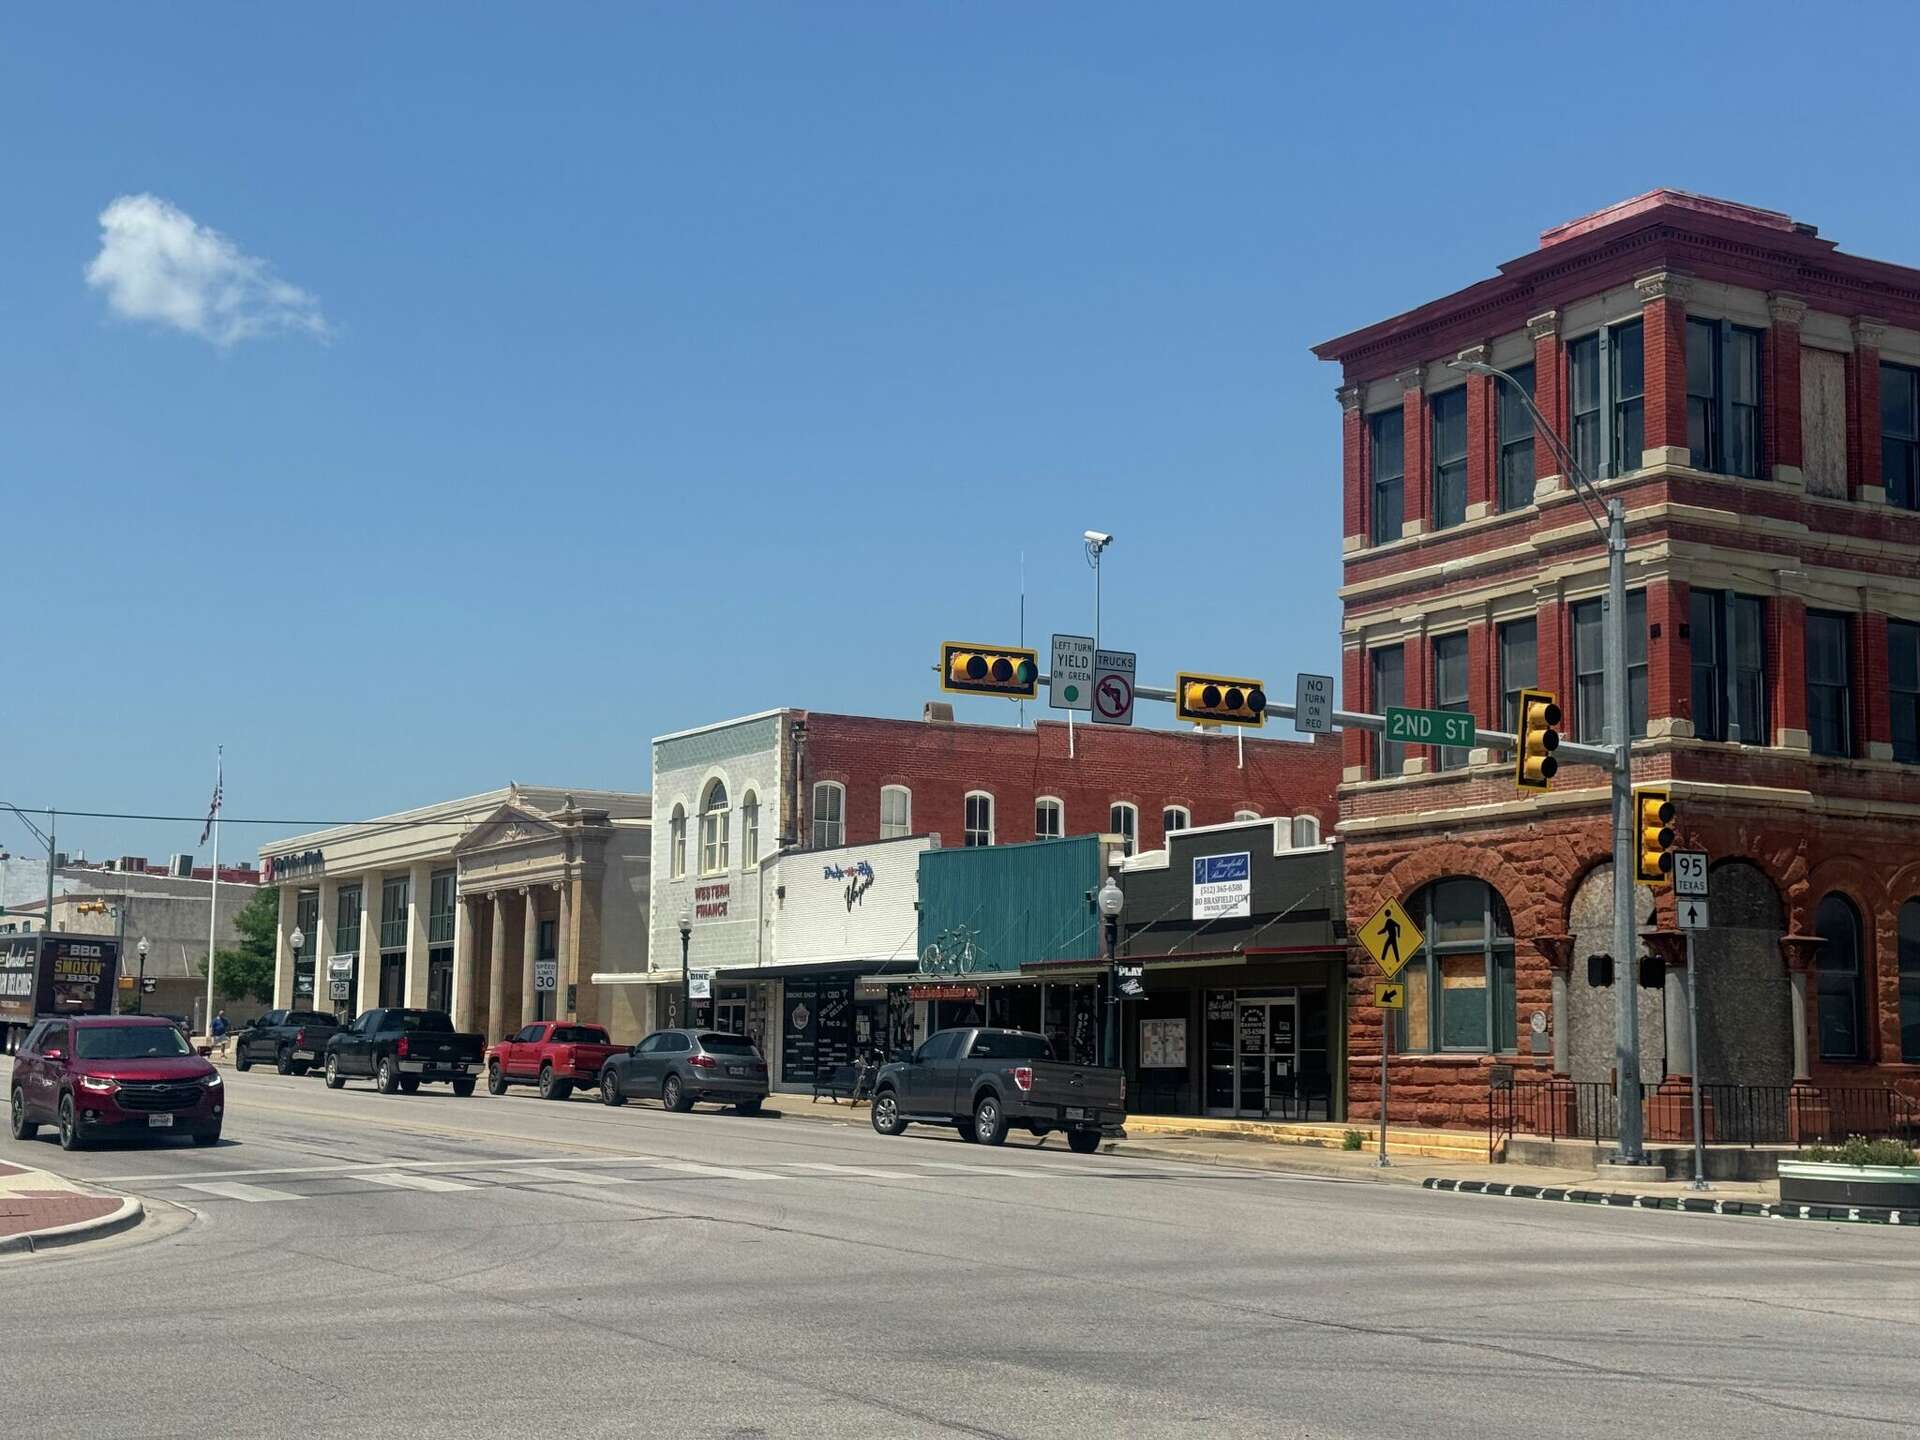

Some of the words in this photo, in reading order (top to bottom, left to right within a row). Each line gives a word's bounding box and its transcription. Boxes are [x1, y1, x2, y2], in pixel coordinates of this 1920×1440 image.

[1055, 641, 1071, 650] LEFT
[1074, 642, 1092, 653] TURN
[1058, 654, 1089, 669] YIELD
[1098, 655, 1134, 668] TRUCKS
[1053, 670, 1064, 679] ON
[1068, 671, 1091, 681] GREEN
[1307, 680, 1323, 691] NO
[1304, 693, 1326, 704] TURN
[1308, 706, 1320, 716] ON
[1305, 718, 1322, 728] RED
[1392, 714, 1432, 737] 2ND
[1445, 719, 1469, 741] ST
[1679, 857, 1702, 877] 95
[1679, 880, 1705, 891] TEXAS
[695, 883, 729, 902] WESTERN
[696, 901, 728, 919] FINANCE
[70, 944, 103, 957] BBQ
[690, 973, 710, 981] DINE
[1118, 967, 1143, 977] PLAY
[536, 976, 555, 988] 30
[334, 983, 346, 993] 95
